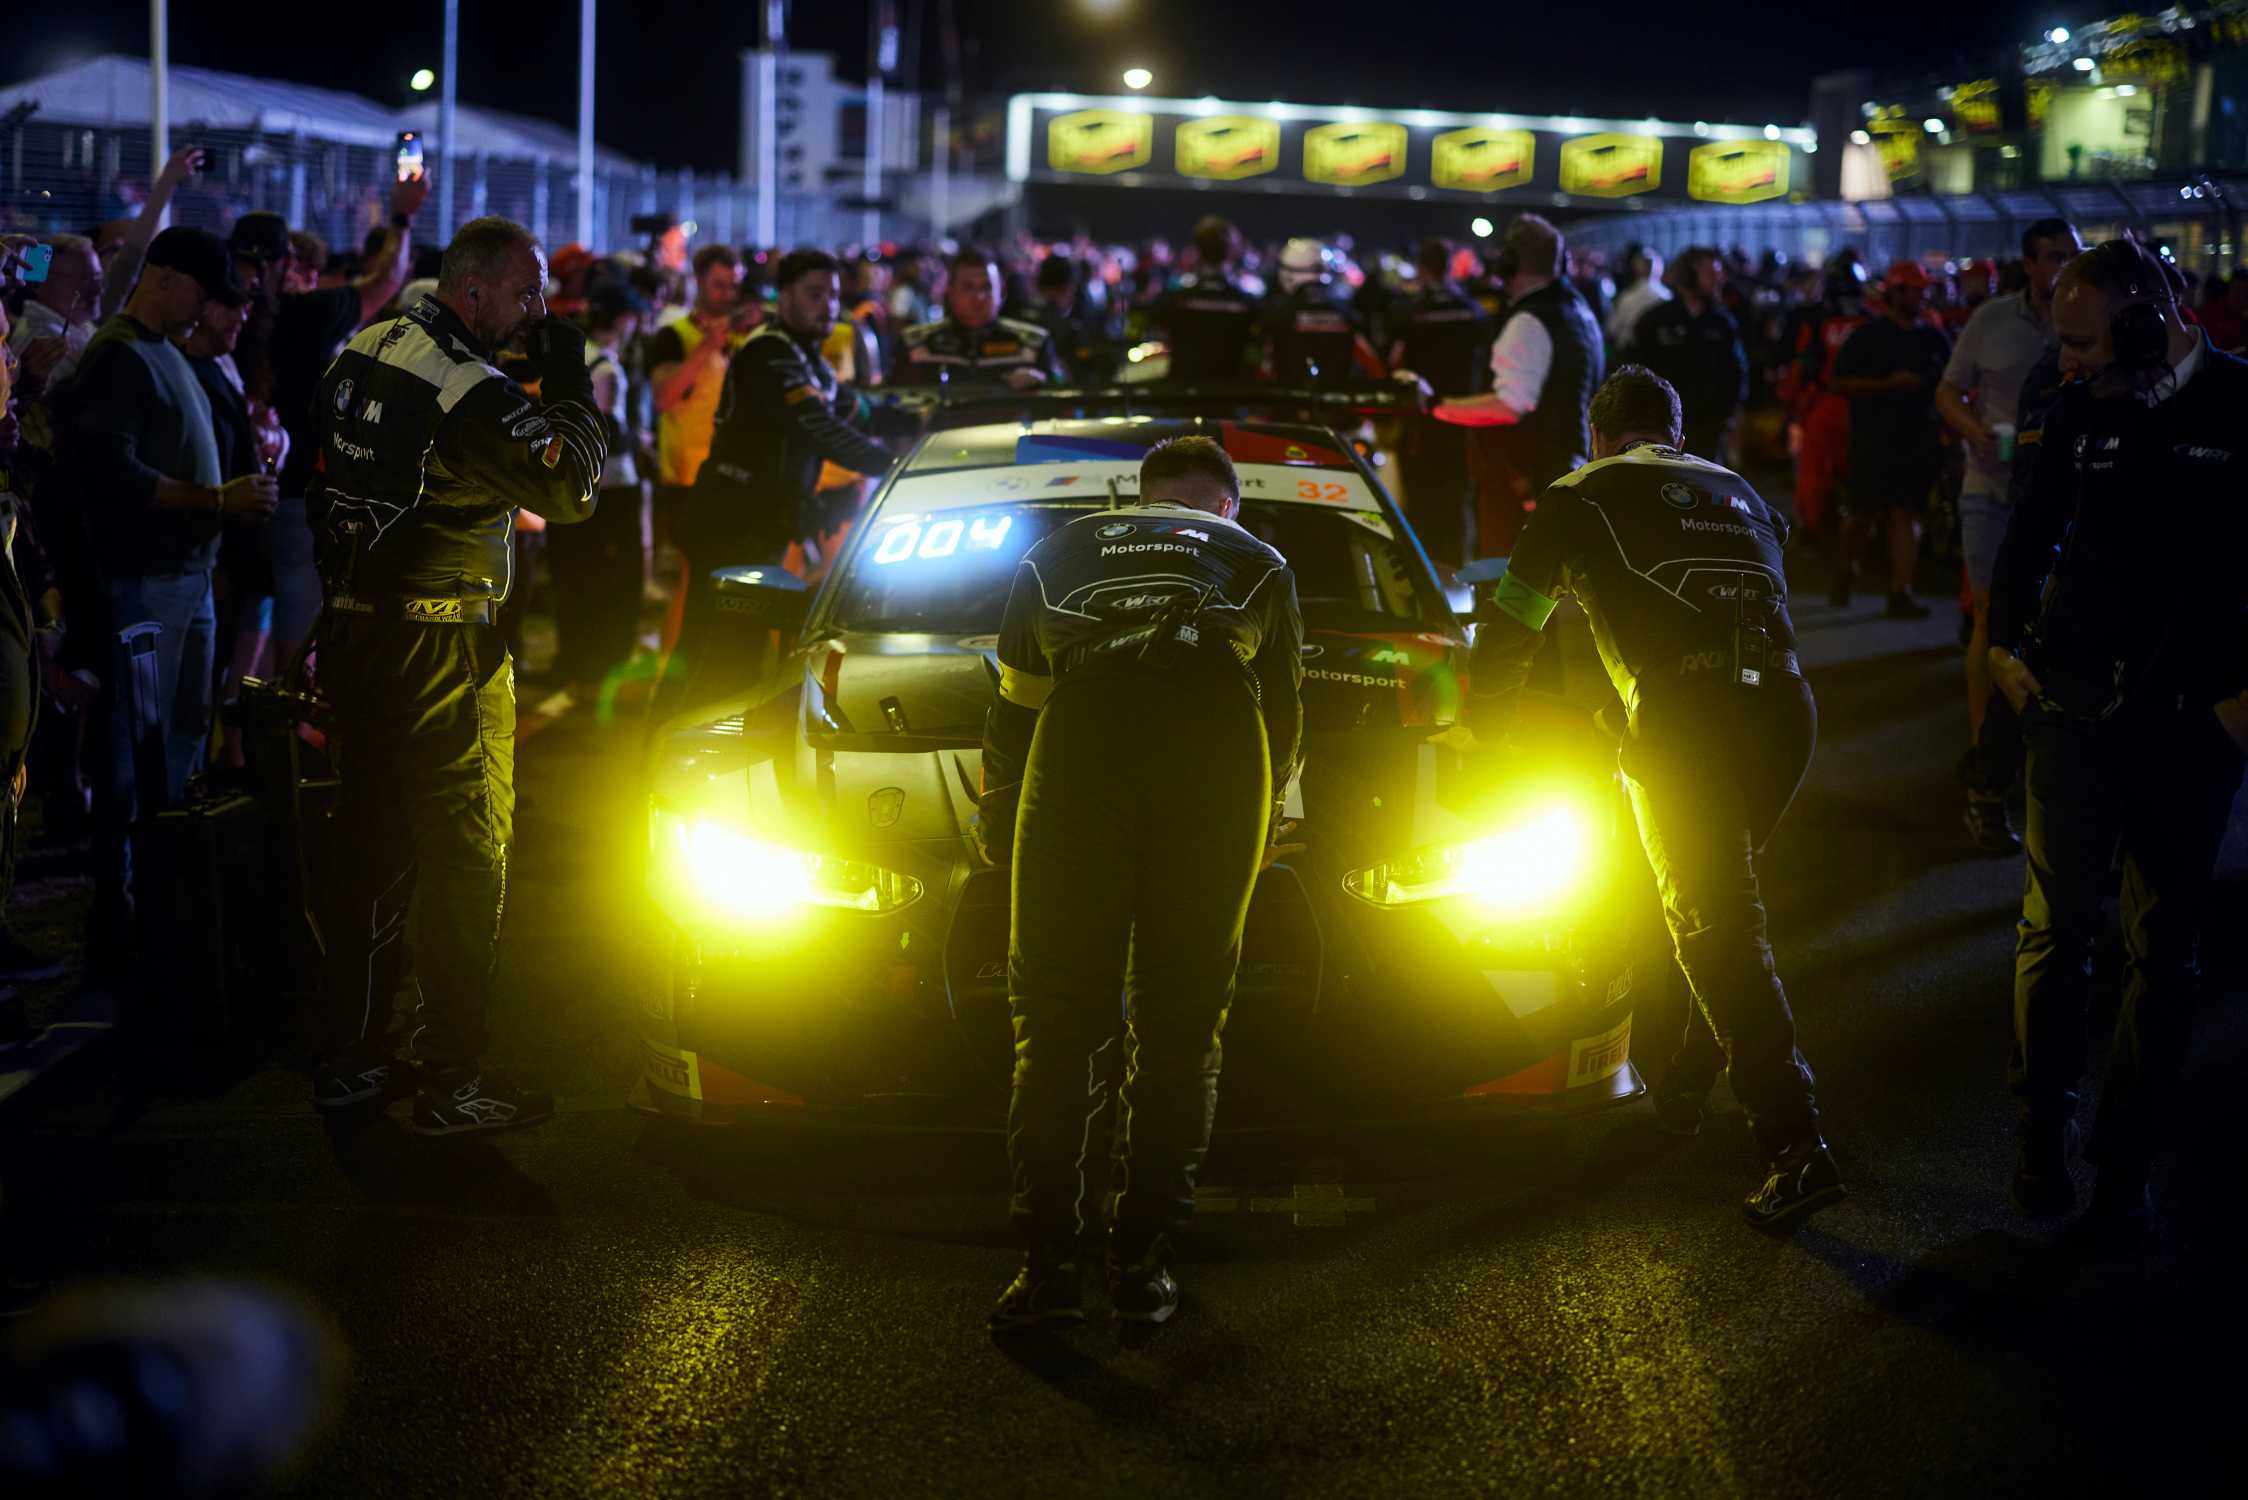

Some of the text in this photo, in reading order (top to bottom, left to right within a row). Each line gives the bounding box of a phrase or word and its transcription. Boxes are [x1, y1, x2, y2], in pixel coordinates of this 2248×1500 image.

[1297, 479, 1348, 503] 32
[872, 515, 1012, 565] 004
[1680, 518, 1760, 544] Motorsport
[1100, 543, 1201, 557] Motorsport
